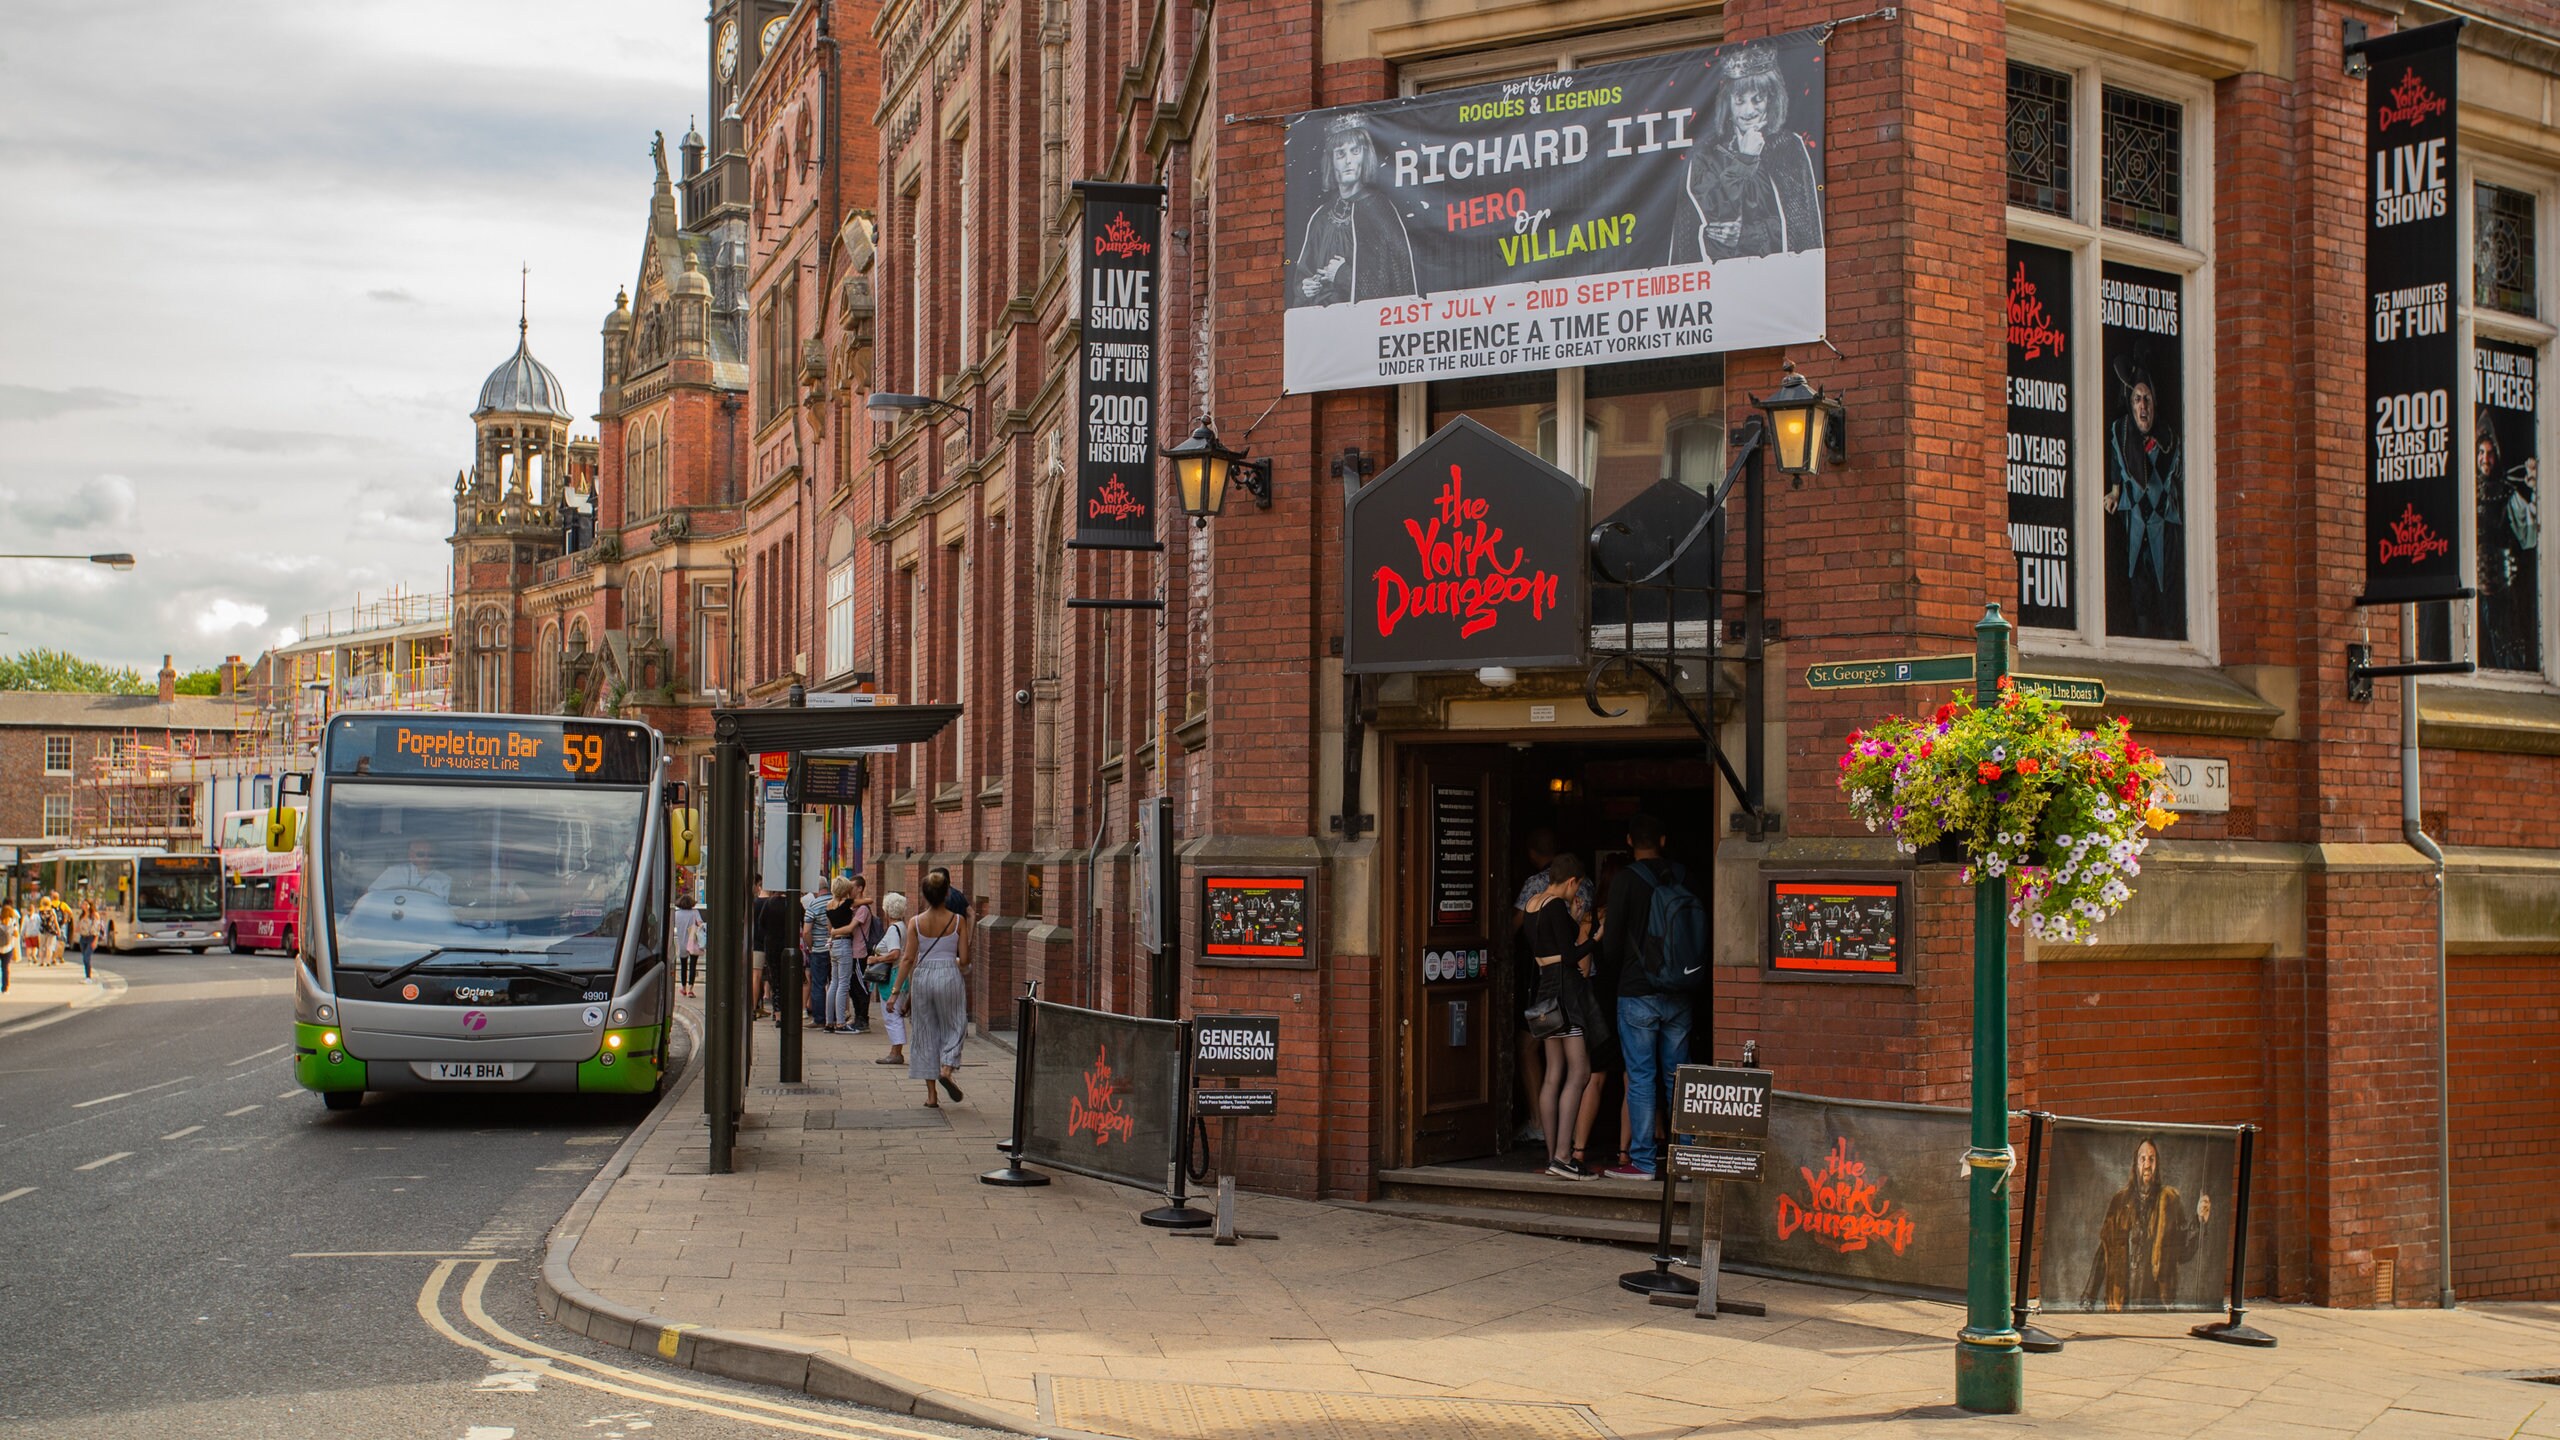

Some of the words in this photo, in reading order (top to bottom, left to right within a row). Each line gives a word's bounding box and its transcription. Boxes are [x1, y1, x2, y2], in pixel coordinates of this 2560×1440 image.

[1503, 72, 1574, 104] yorkshire
[2401, 66, 2421, 88] the
[1459, 97, 1525, 124] ROGUES
[1529, 96, 1541, 115] &
[1545, 86, 1622, 112] LEGENDS
[2390, 85, 2435, 109] York
[2378, 98, 2447, 132] Dungeon
[1394, 124, 1589, 188] RICHARD
[1606, 106, 1694, 158] III
[2377, 137, 2446, 200] LIVE
[1114, 210, 1131, 229] the
[1446, 187, 1527, 232] HERO
[1514, 205, 1551, 235] or
[2376, 188, 2447, 228] SHOWS
[1094, 235, 1151, 259] Dungeon
[1104, 223, 1141, 244] York
[1498, 212, 1637, 267] VILLAIN?
[1092, 268, 1150, 309] LIVE
[2012, 260, 2037, 297] the
[2101, 278, 2122, 300] HEAD
[2123, 282, 2147, 306] BACK
[2148, 287, 2160, 308] TO
[2161, 289, 2177, 311] THE
[1379, 304, 1432, 327] 21ST
[1441, 295, 1497, 320] JULY
[1526, 285, 1569, 310] 2ND
[1577, 270, 1711, 305] SEPTEMBER
[2374, 292, 2390, 312] 75
[2391, 282, 2447, 309] MINUTES
[1091, 306, 1149, 331] SHOWS
[1378, 320, 1520, 360] EXPERIENCE
[1527, 317, 1544, 343] A
[1550, 309, 1613, 341] TIME
[1617, 305, 1651, 334] OF
[1656, 299, 1713, 331] WAR
[2101, 298, 2122, 326] BAD
[2124, 302, 2147, 330] OLD
[2148, 306, 2178, 336] DAYS
[2375, 310, 2401, 343] OF
[2405, 302, 2447, 339] FUN
[1090, 342, 1103, 357] 75
[1104, 343, 1149, 359] MINUTES
[1378, 356, 1427, 377] UNDER
[1428, 353, 1460, 373] THE
[1460, 350, 1498, 370] RULE
[1499, 348, 1521, 366] OF
[1522, 346, 1553, 364] THE
[1555, 340, 1604, 362] GREAT
[1606, 334, 1674, 356] YORKIST
[1675, 328, 1713, 349] KING
[2007, 325, 2065, 361] ungeon
[1090, 357, 1113, 382] OF
[1115, 359, 1148, 383] FUN
[1679, 364, 1723, 381] YORKI
[2493, 351, 2516, 374] HAVE
[2515, 355, 2533, 378] YOU
[2015, 377, 2067, 413] SHOWS
[2485, 371, 2534, 412] PIECES
[1089, 394, 1148, 426] 2000
[2376, 389, 2448, 435] 2000
[1088, 425, 1129, 444] YEARS
[1132, 426, 1148, 444] OF
[2024, 434, 2066, 467] YEARS
[2375, 431, 2425, 458] YEARS
[2428, 427, 2449, 452] OF
[1088, 442, 1147, 464] HISTORY
[2376, 451, 2449, 483] HISTORY
[1099, 486, 1135, 504] York
[1108, 472, 1125, 490] the
[1434, 463, 1490, 527] the
[2006, 463, 2067, 499] HISTORY
[1089, 498, 1145, 521] Dungeon
[2401, 503, 2422, 525] the
[2007, 522, 2068, 557] MINUTES
[2390, 521, 2435, 544] York
[1404, 517, 1525, 581] York
[2379, 538, 2448, 564] Dungeon
[2022, 556, 2068, 608] FUN
[1371, 563, 1559, 640] Dungeon
[1813, 666, 1832, 683] St.
[1833, 664, 1887, 684] George's
[2053, 683, 2071, 699] Line
[2071, 685, 2092, 700] Boats
[397, 728, 501, 758] Poppleton
[507, 732, 543, 758] Bar
[562, 733, 603, 774] 59
[422, 753, 489, 771] Turquoise
[491, 754, 520, 771] Line
[761, 754, 783, 767] FIESTA
[2165, 764, 2192, 787] ND
[2206, 766, 2225, 789] ST.
[463, 985, 495, 999] Optare
[582, 990, 609, 1001] 49901
[1198, 1046, 1274, 1061] ADMISSION
[1199, 1029, 1275, 1047] GENERAL
[440, 1064, 472, 1078] YJ14
[476, 1064, 505, 1078] BHA
[1095, 1044, 1112, 1078] the
[1084, 1071, 1123, 1115] York
[1683, 1099, 1763, 1118] ENTRANCE
[1684, 1082, 1764, 1103] PRIORITY
[1068, 1095, 1134, 1146] Dungeon
[1823, 1136, 1866, 1178] the
[1800, 1165, 1891, 1217] York
[1776, 1191, 1915, 1257] Dungeon
